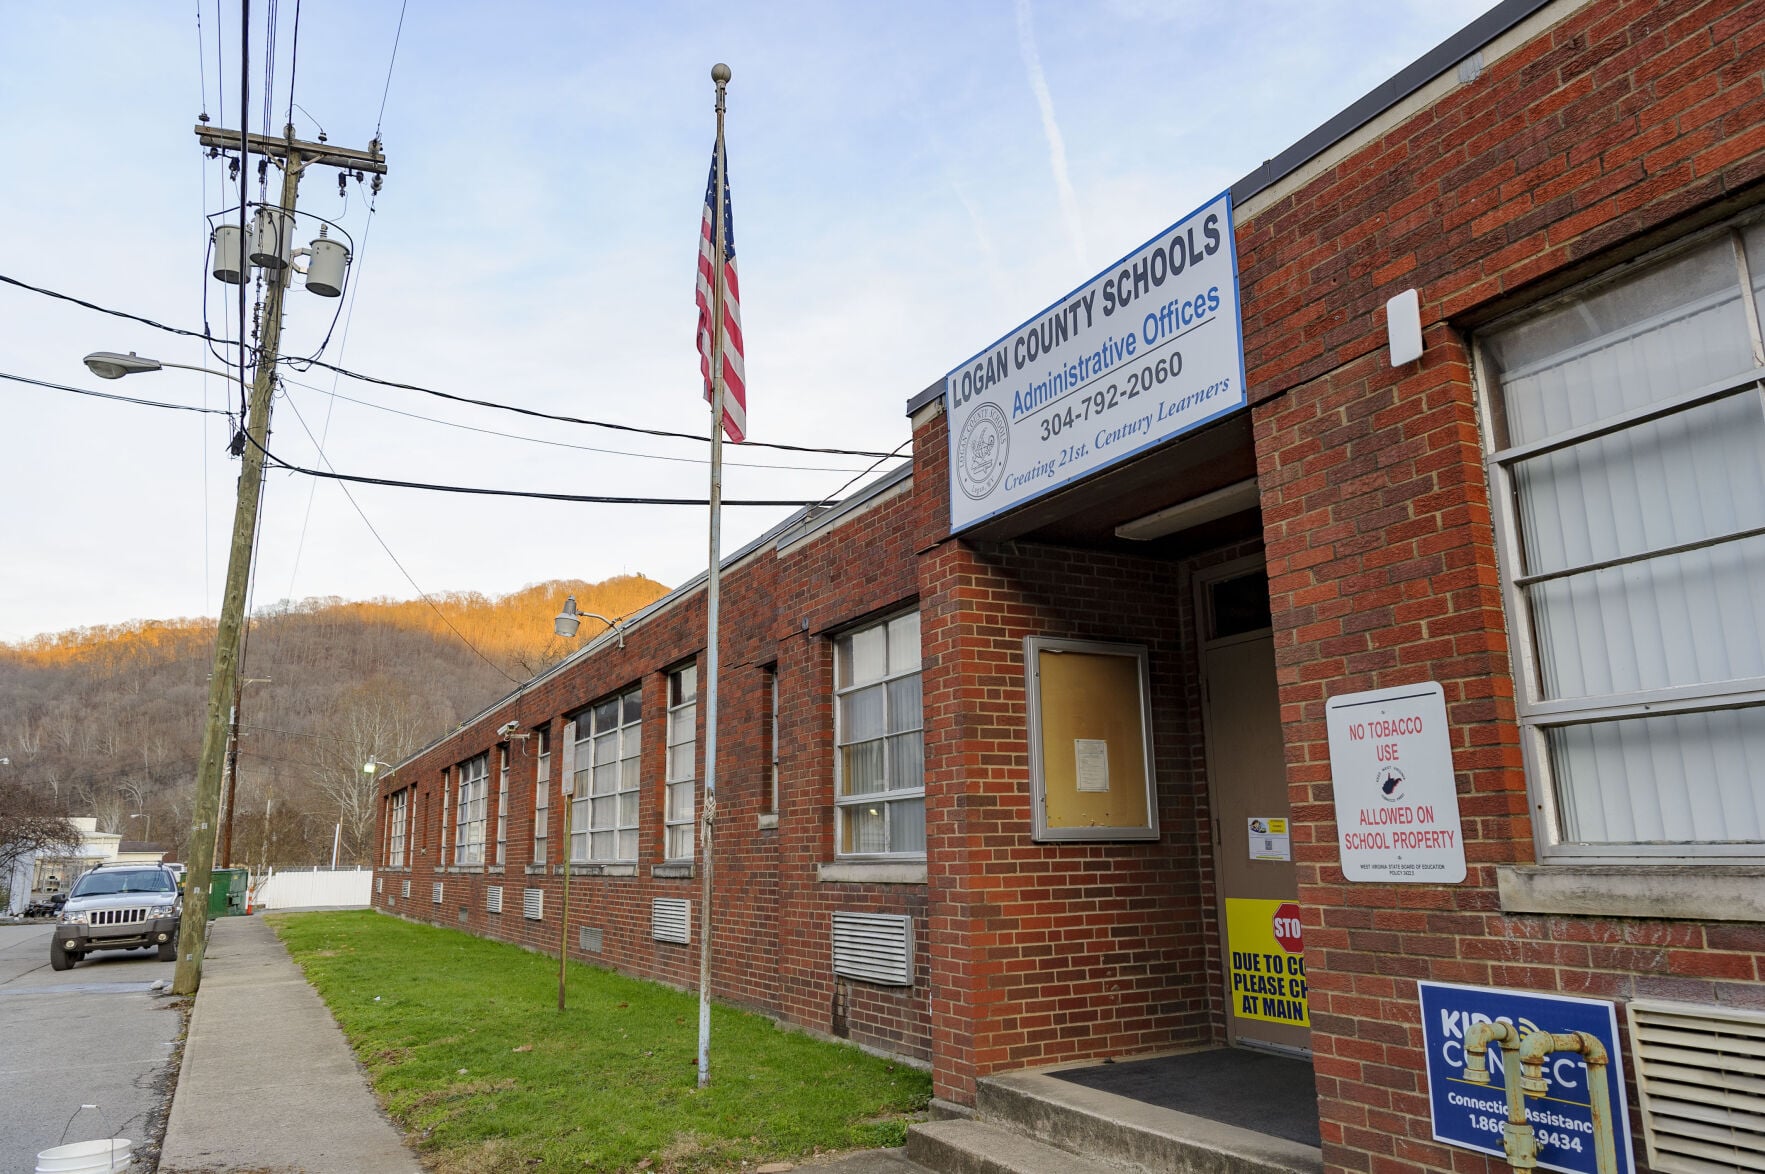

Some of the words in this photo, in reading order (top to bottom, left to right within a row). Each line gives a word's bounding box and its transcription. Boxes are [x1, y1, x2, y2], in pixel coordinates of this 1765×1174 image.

[953, 346, 1008, 409] LOGAN
[1014, 289, 1096, 370] COUNTY
[1102, 213, 1221, 317] SCHOOLS
[1012, 333, 1136, 419] Administrative
[1142, 286, 1220, 345] Offices
[1040, 351, 1183, 441] 304-792-2060
[1004, 457, 1055, 492] Creating
[1058, 442, 1089, 469] 21st.
[1094, 412, 1153, 450] Century
[1157, 376, 1230, 423] Learners
[1349, 723, 1365, 741] NO
[1368, 716, 1423, 739] TOBACCO
[1376, 743, 1400, 762] USE
[1360, 806, 1413, 826] ALLOWED
[1416, 805, 1435, 824] ON
[1344, 832, 1390, 850] SCHOOL
[1392, 830, 1455, 849] PROPERTY
[1274, 917, 1302, 939] STO
[1233, 952, 1260, 972] DUE
[1263, 954, 1284, 975] TO
[1233, 973, 1286, 997] PLEASE
[1242, 995, 1259, 1015] AT
[1262, 997, 1304, 1022] MAIN
[1441, 1008, 1513, 1039] KI
[1525, 1108, 1593, 1134] Assistanc
